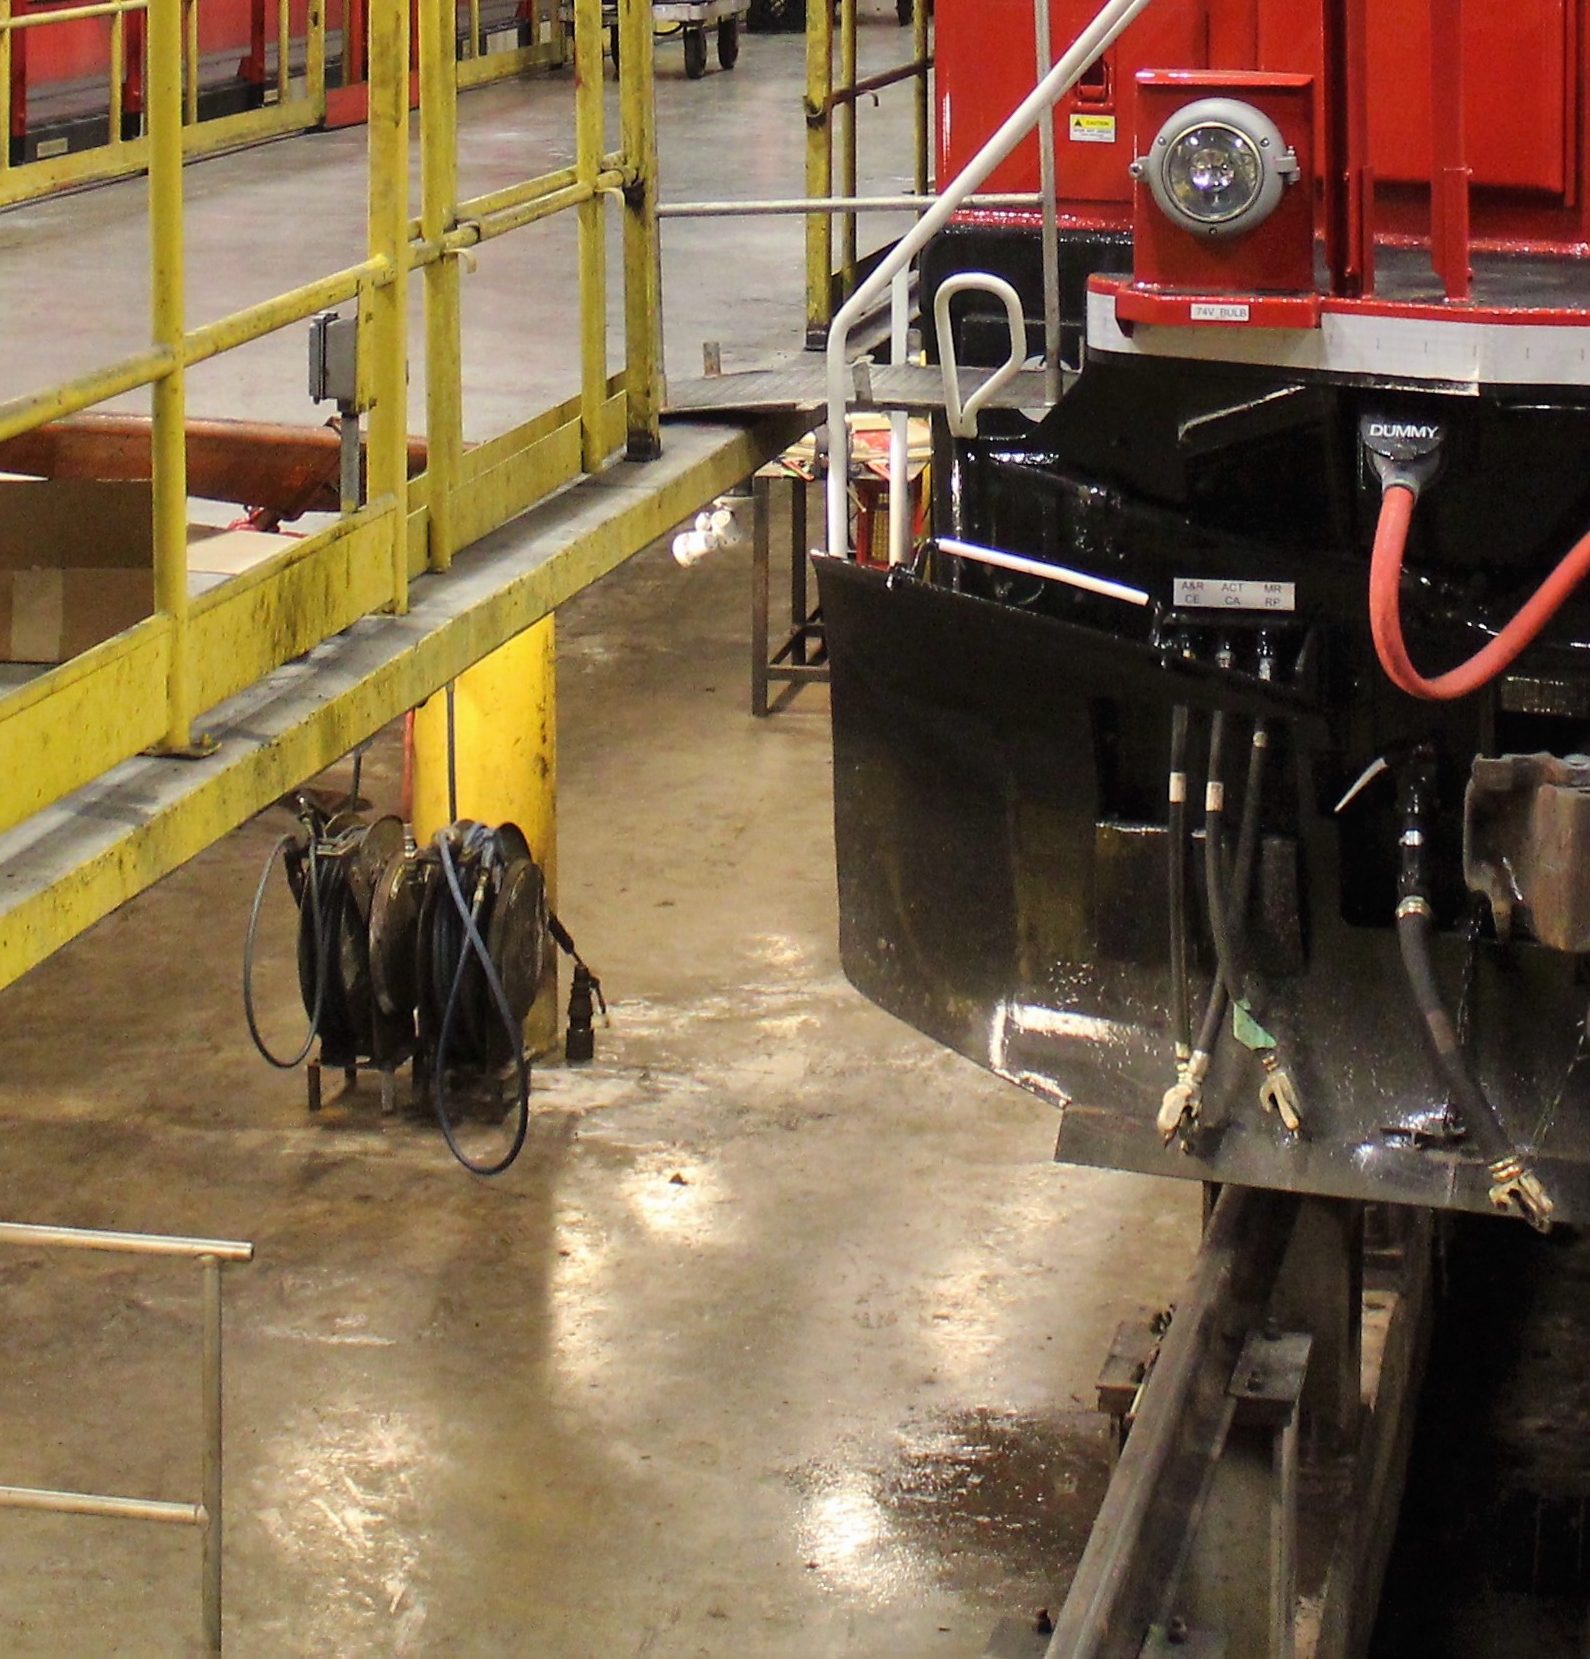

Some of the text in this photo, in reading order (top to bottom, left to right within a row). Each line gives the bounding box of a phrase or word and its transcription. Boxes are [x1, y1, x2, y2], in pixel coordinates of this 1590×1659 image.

[1197, 307, 1247, 318] 74V BULB
[1370, 423, 1439, 439] DUMMY
[1181, 581, 1282, 593] A&R ACT MR
[1185, 594, 1280, 607] CE CA RP
